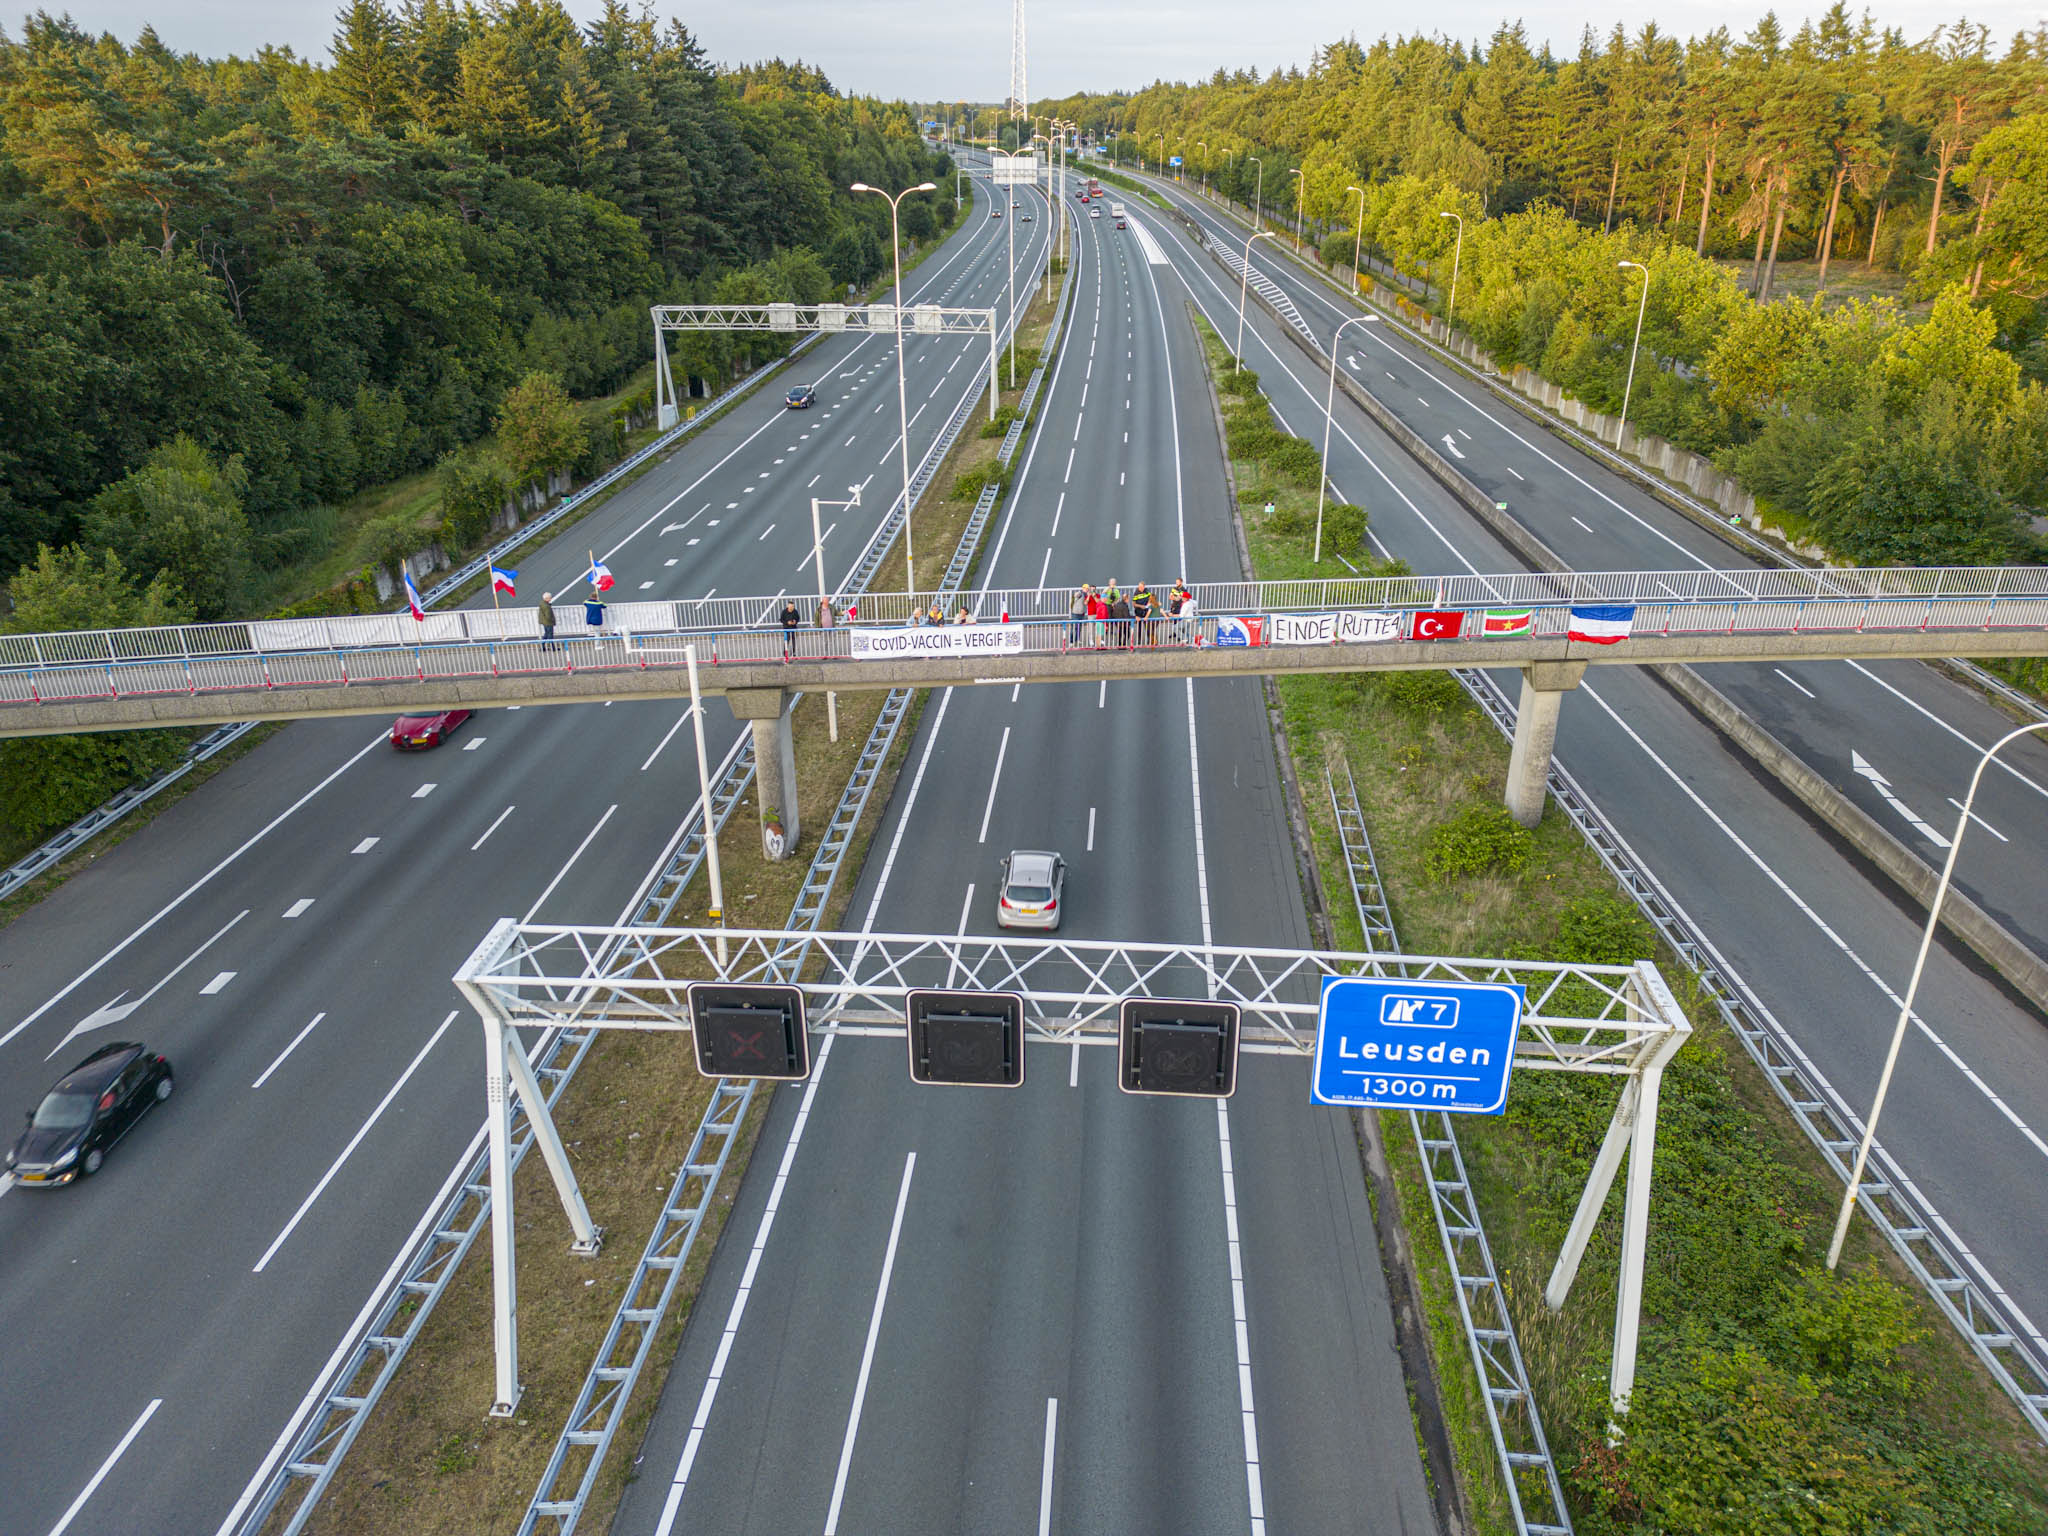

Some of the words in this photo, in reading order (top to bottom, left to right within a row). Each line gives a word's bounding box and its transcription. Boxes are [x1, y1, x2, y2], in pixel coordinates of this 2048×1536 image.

[1276, 618, 1331, 641] EINDE
[872, 634, 952, 651] COVID-VACCIN
[964, 632, 1004, 648] VERGIF
[1430, 1003, 1448, 1021] 7
[1339, 1036, 1490, 1066] Leusden
[1362, 1078, 1426, 1097] 1300
[1432, 1083, 1457, 1099] m
